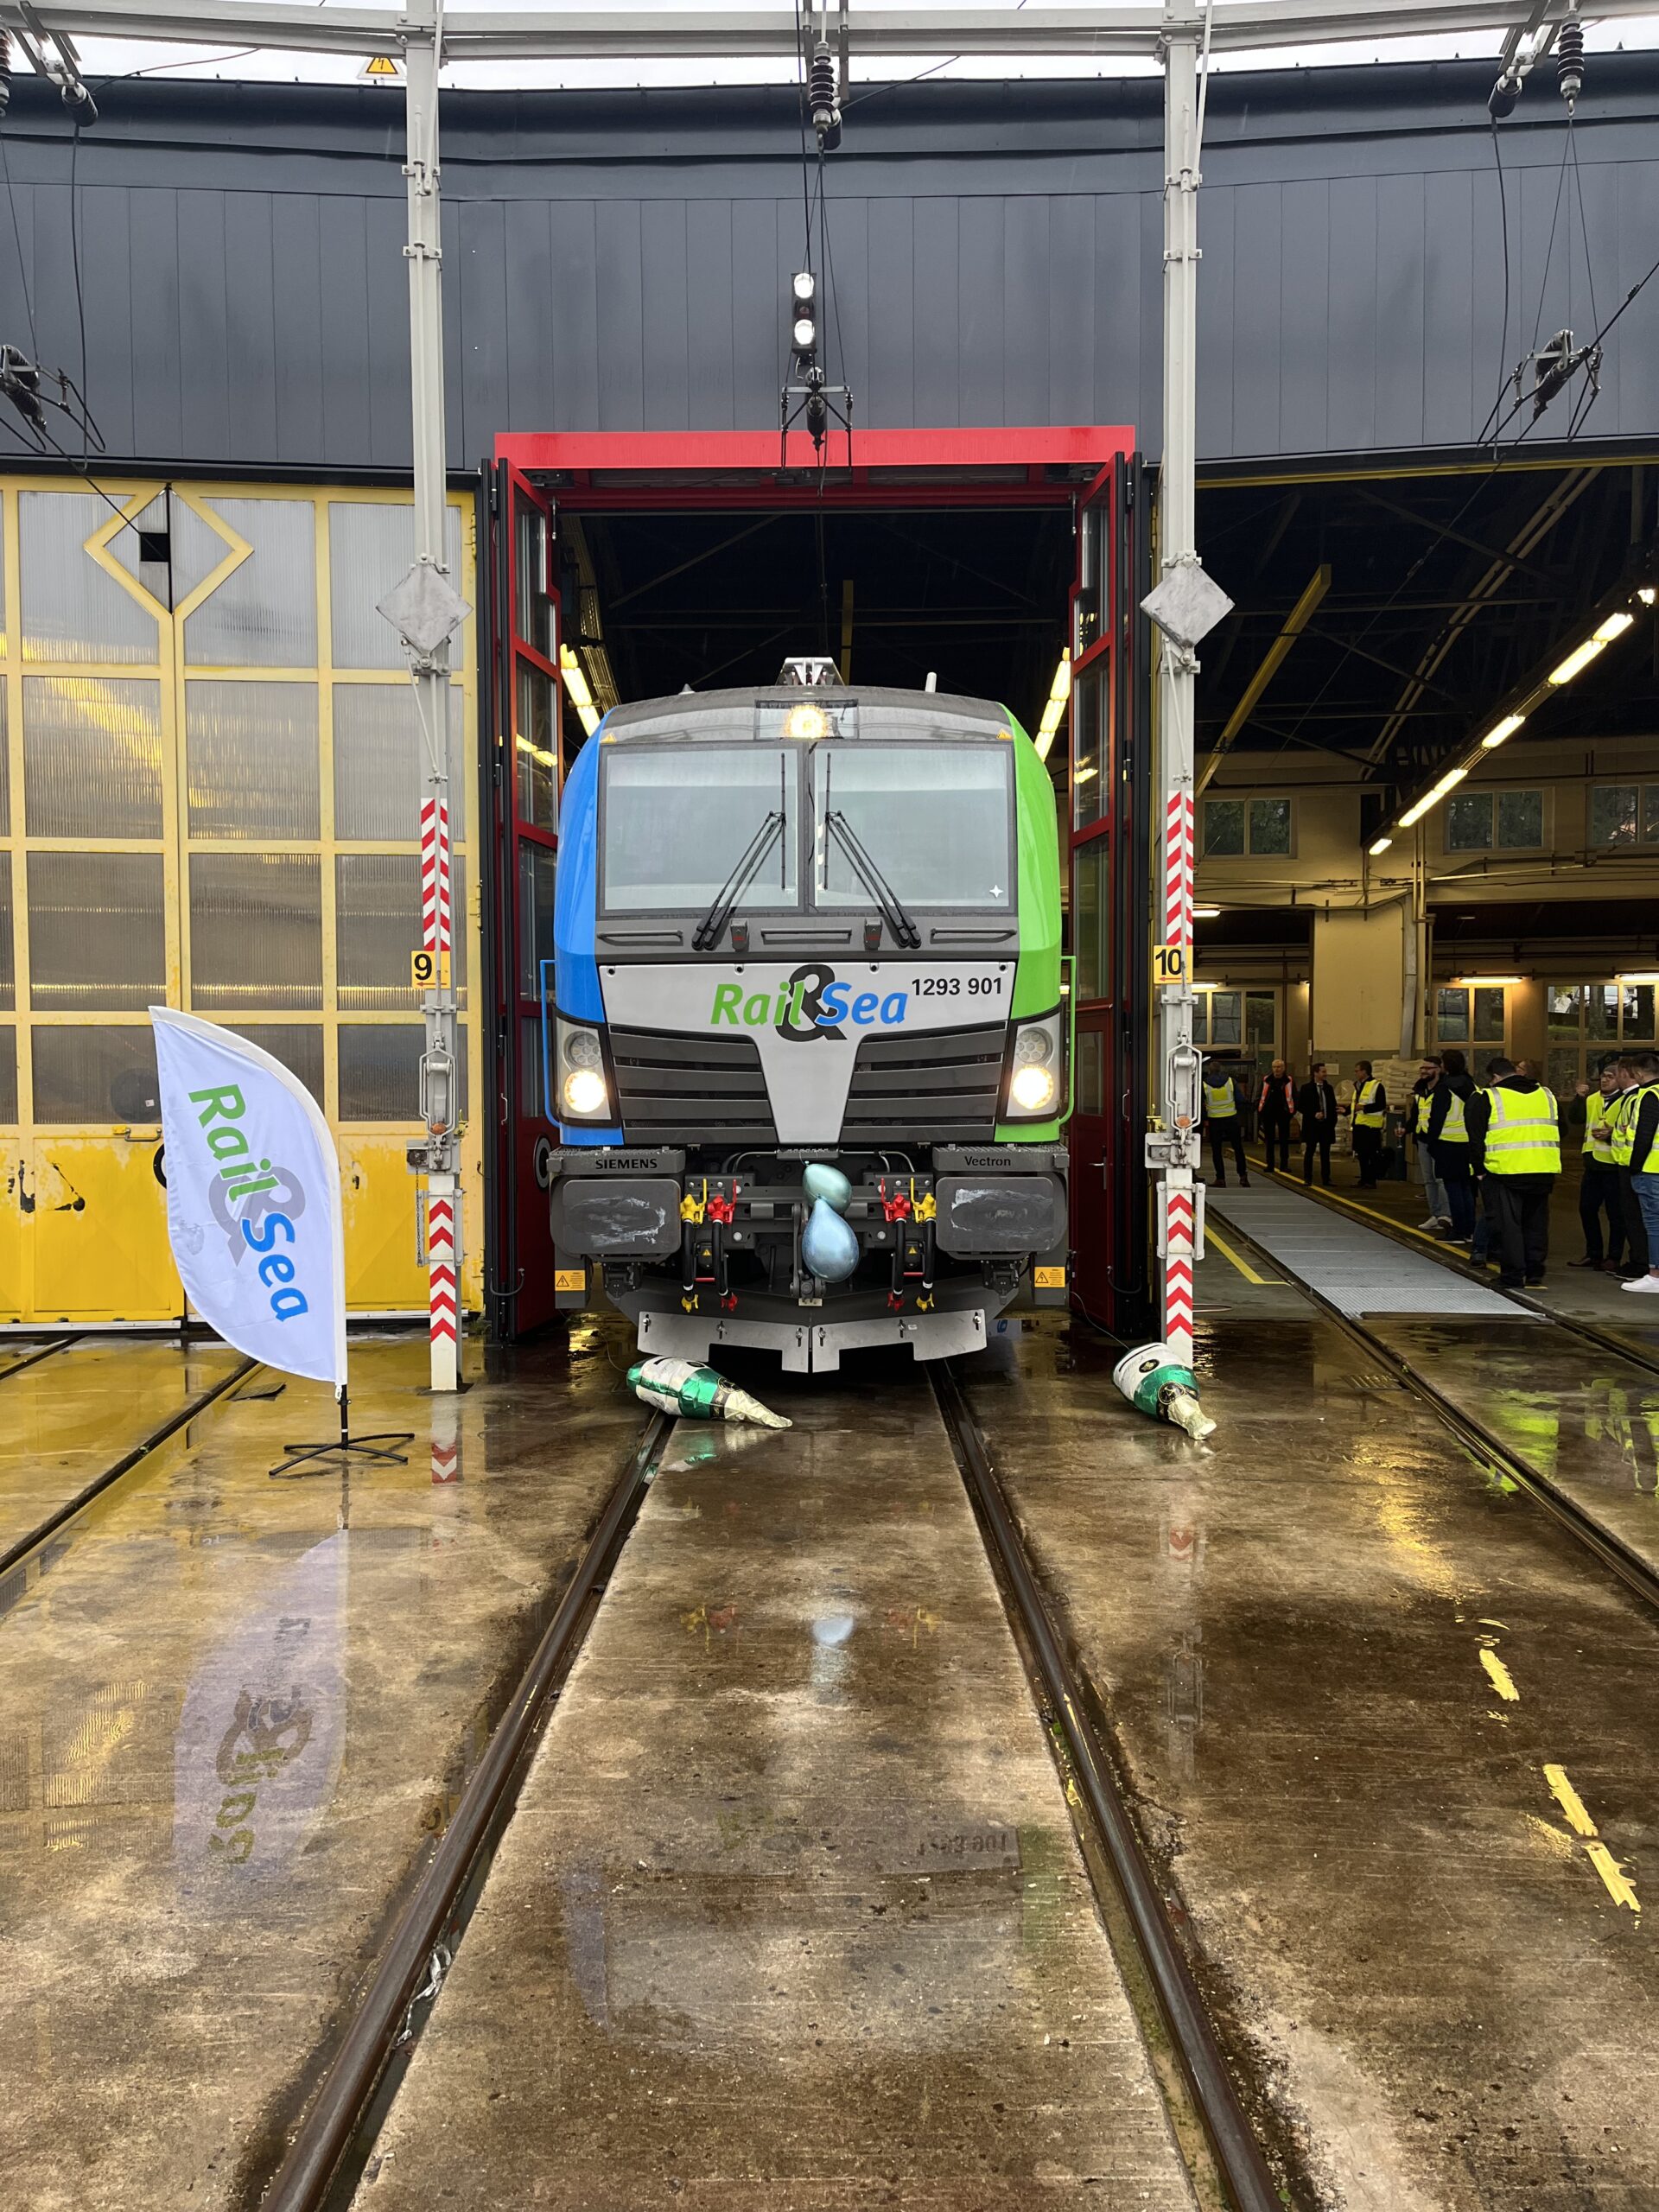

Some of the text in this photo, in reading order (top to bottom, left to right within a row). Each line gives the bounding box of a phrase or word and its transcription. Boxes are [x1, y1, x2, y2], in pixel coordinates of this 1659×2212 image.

[415, 953, 432, 981] 9
[1155, 949, 1181, 976] 10
[912, 977, 1002, 996] 1293 901
[595, 1158, 658, 1169] SIEMENS
[964, 1155, 1011, 1166] Vectron
